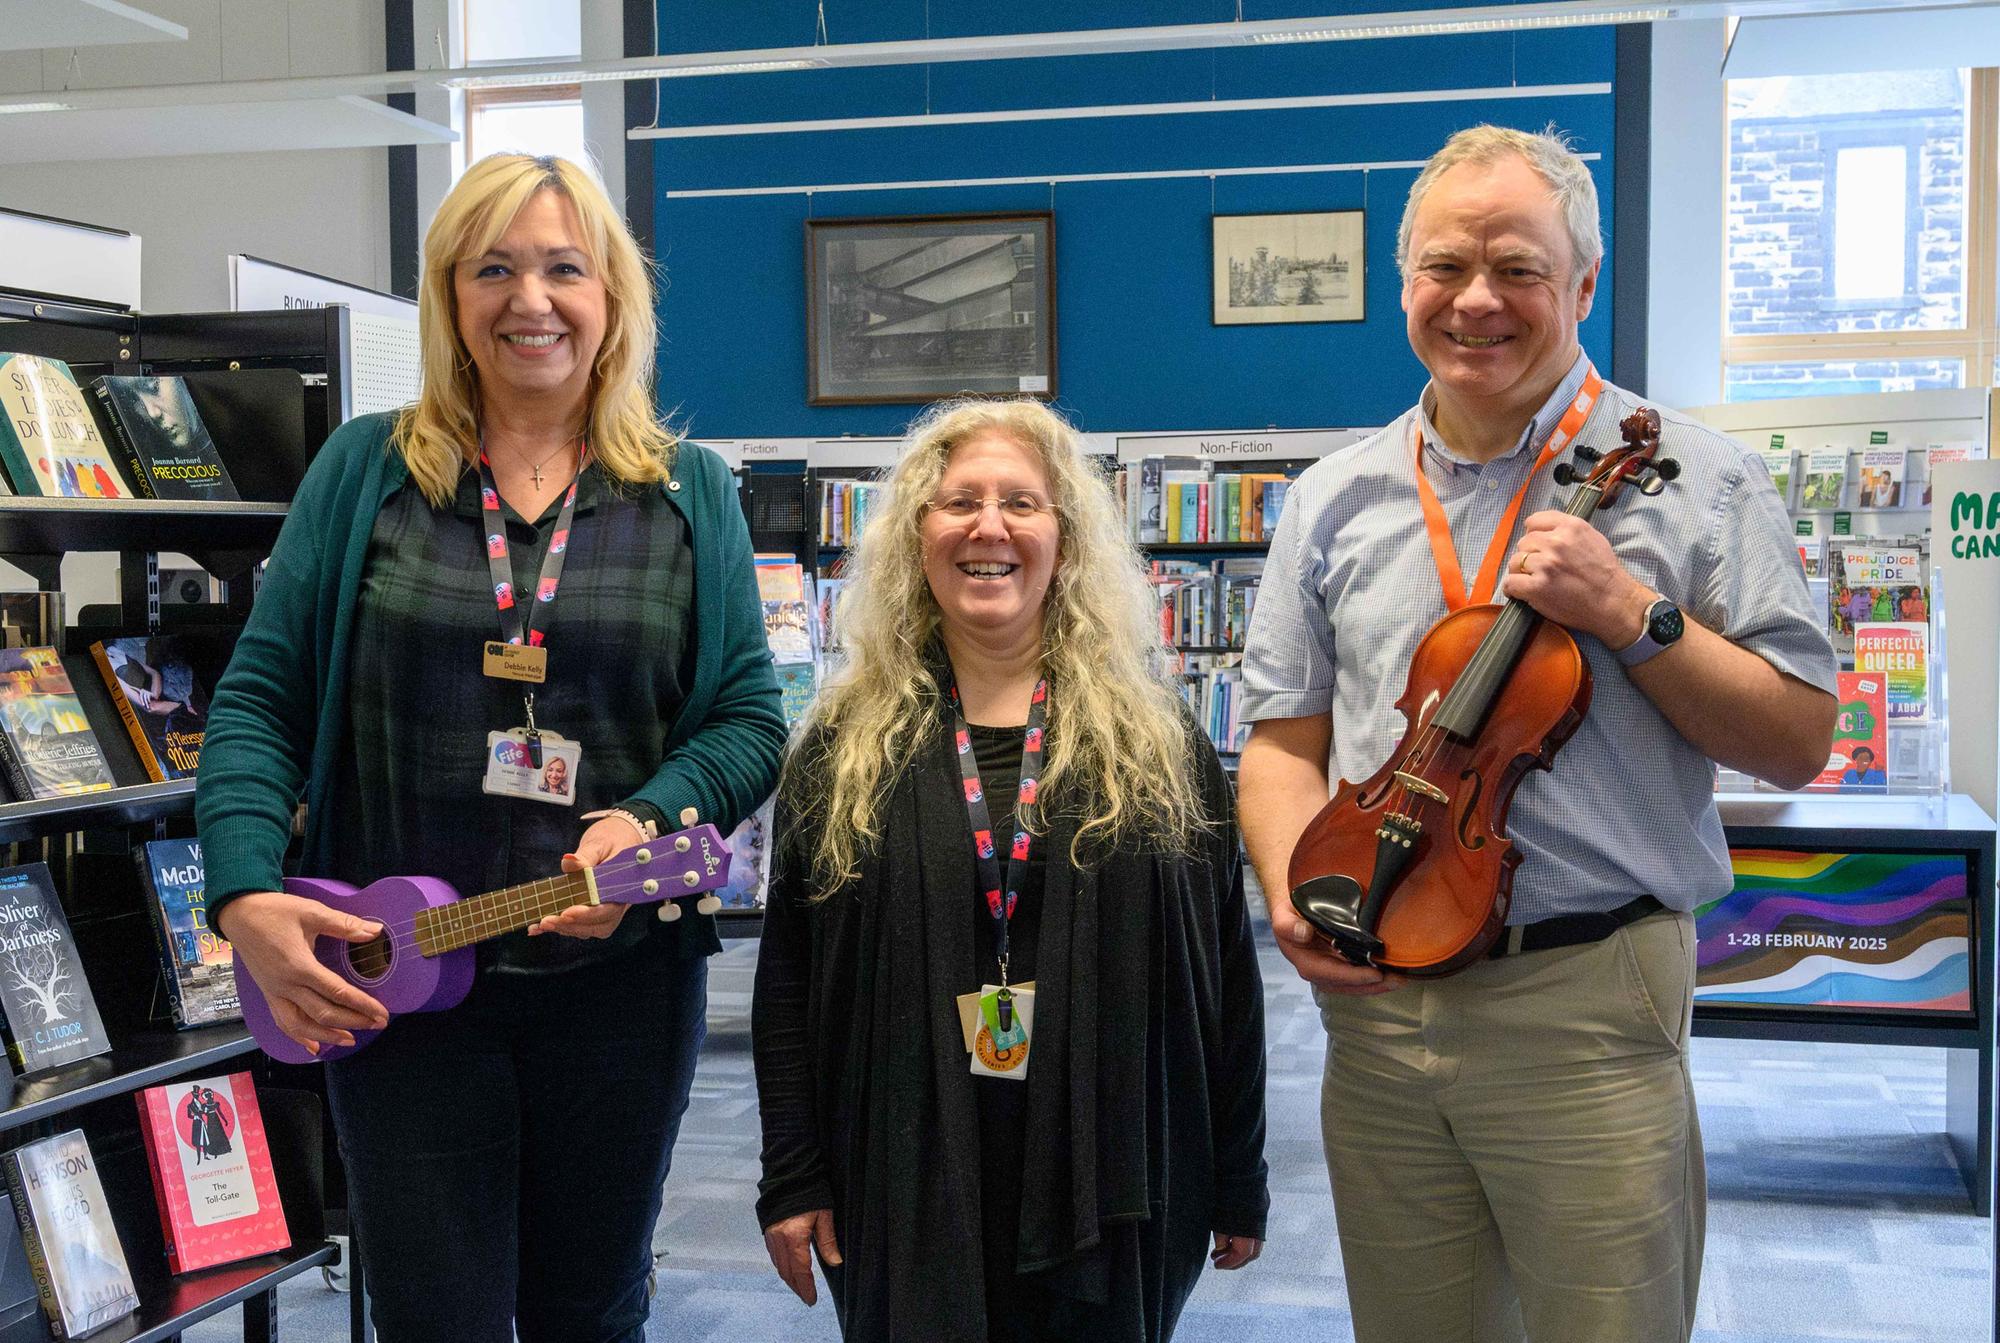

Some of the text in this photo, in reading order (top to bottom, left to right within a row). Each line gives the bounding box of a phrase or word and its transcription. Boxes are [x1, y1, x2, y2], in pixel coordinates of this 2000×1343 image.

[11, 373, 69, 396] SIER
[21, 396, 78, 418] LDIES
[52, 421, 98, 442] LUNH
[743, 443, 778, 454] Fiction
[1200, 441, 1273, 454] Non-Fiction
[152, 455, 202, 466] Joanna Barnard
[152, 464, 221, 479] PRECOCIOUS
[1951, 534, 2000, 560] CAN
[1847, 554, 1916, 566] PREJUDICE
[1860, 568, 1904, 580] PRIDE
[764, 609, 808, 627] anielle
[1859, 637, 1921, 651] PERFECTLY
[504, 661, 543, 675] Debbie Kelly
[1864, 652, 1917, 671] QUEER
[63, 743, 97, 758] Jeffries
[499, 747, 525, 764] Fife
[700, 836, 717, 877] chord
[13, 895, 20, 905] A
[0, 904, 39, 924] Sliver
[20, 920, 29, 931] of
[1727, 932, 1888, 951] 1-28 FEBRUARY 2025
[51, 1021, 83, 1039] TUDOR
[190, 1165, 244, 1182] GEORGETTE HEYER
[212, 1182, 227, 1191] The
[205, 1192, 240, 1205] Toll-Gate
[12, 1185, 32, 1232] HEWSON
[34, 1266, 51, 1298] FJORD
